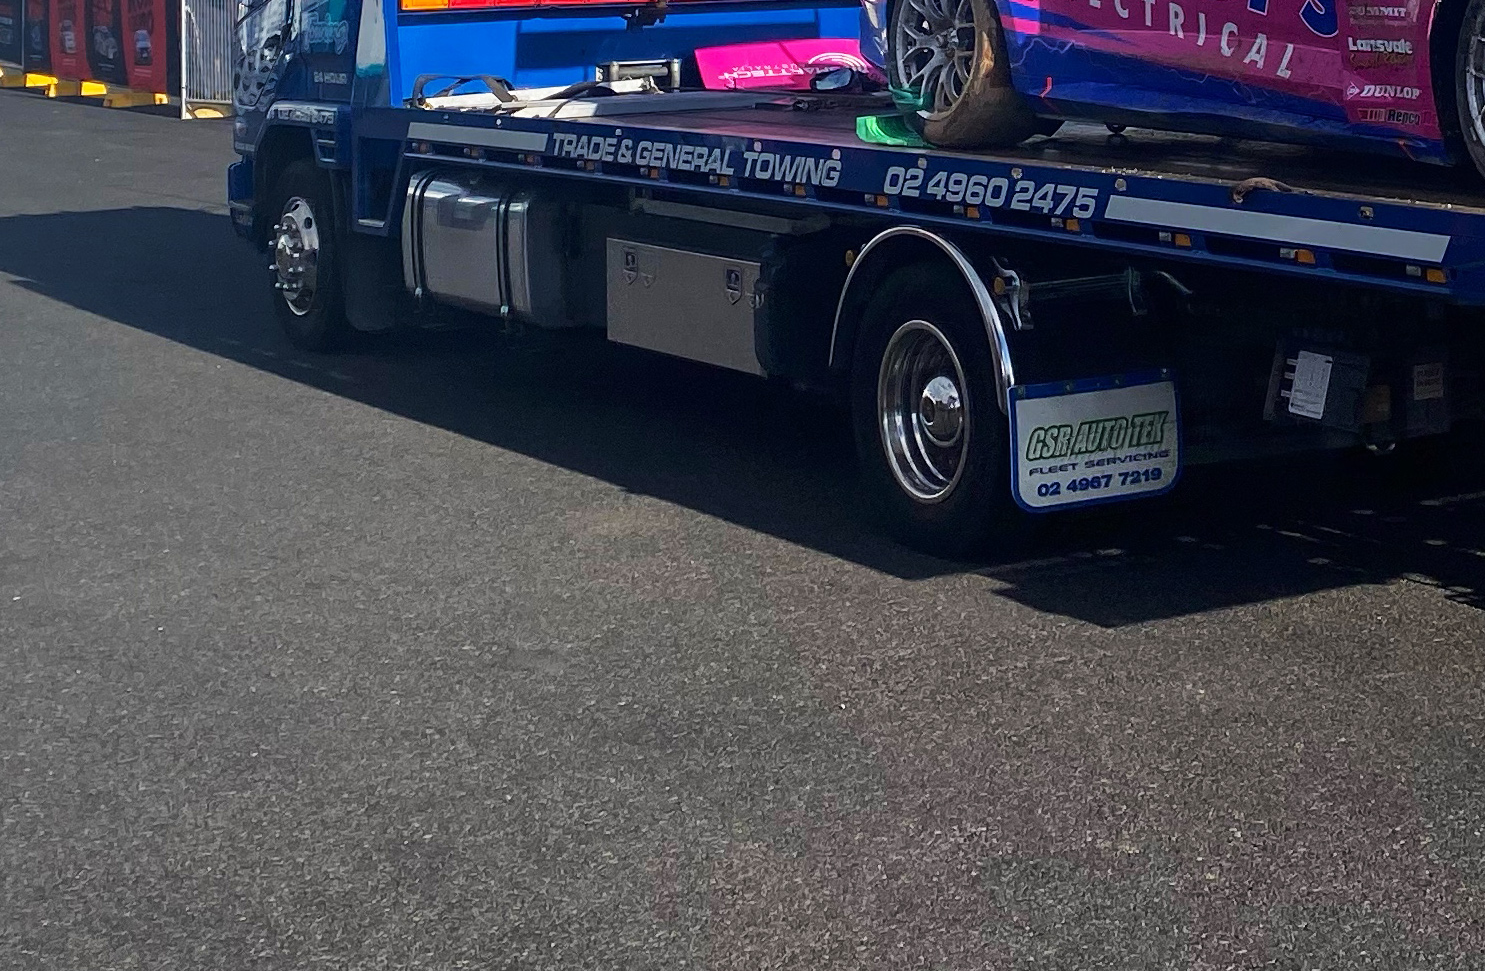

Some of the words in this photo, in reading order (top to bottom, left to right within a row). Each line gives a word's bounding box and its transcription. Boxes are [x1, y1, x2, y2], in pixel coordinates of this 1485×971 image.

[1348, 37, 1413, 54] Lansvale
[1360, 85, 1422, 99] DUNLOP
[552, 133, 616, 162] TRADE
[618, 140, 632, 163] &
[635, 141, 734, 175] GENERAL
[743, 151, 841, 187] TOWING
[883, 166, 922, 197] 02
[926, 172, 1009, 207] 4960
[1012, 179, 1098, 219] 2475
[1071, 417, 1128, 454] AUTO
[1029, 463, 1079, 476] FLEET
[1085, 450, 1171, 469] SERVICING
[1037, 482, 1061, 497] 02
[1066, 474, 1112, 492] 4967
[1118, 468, 1162, 485] 7219
